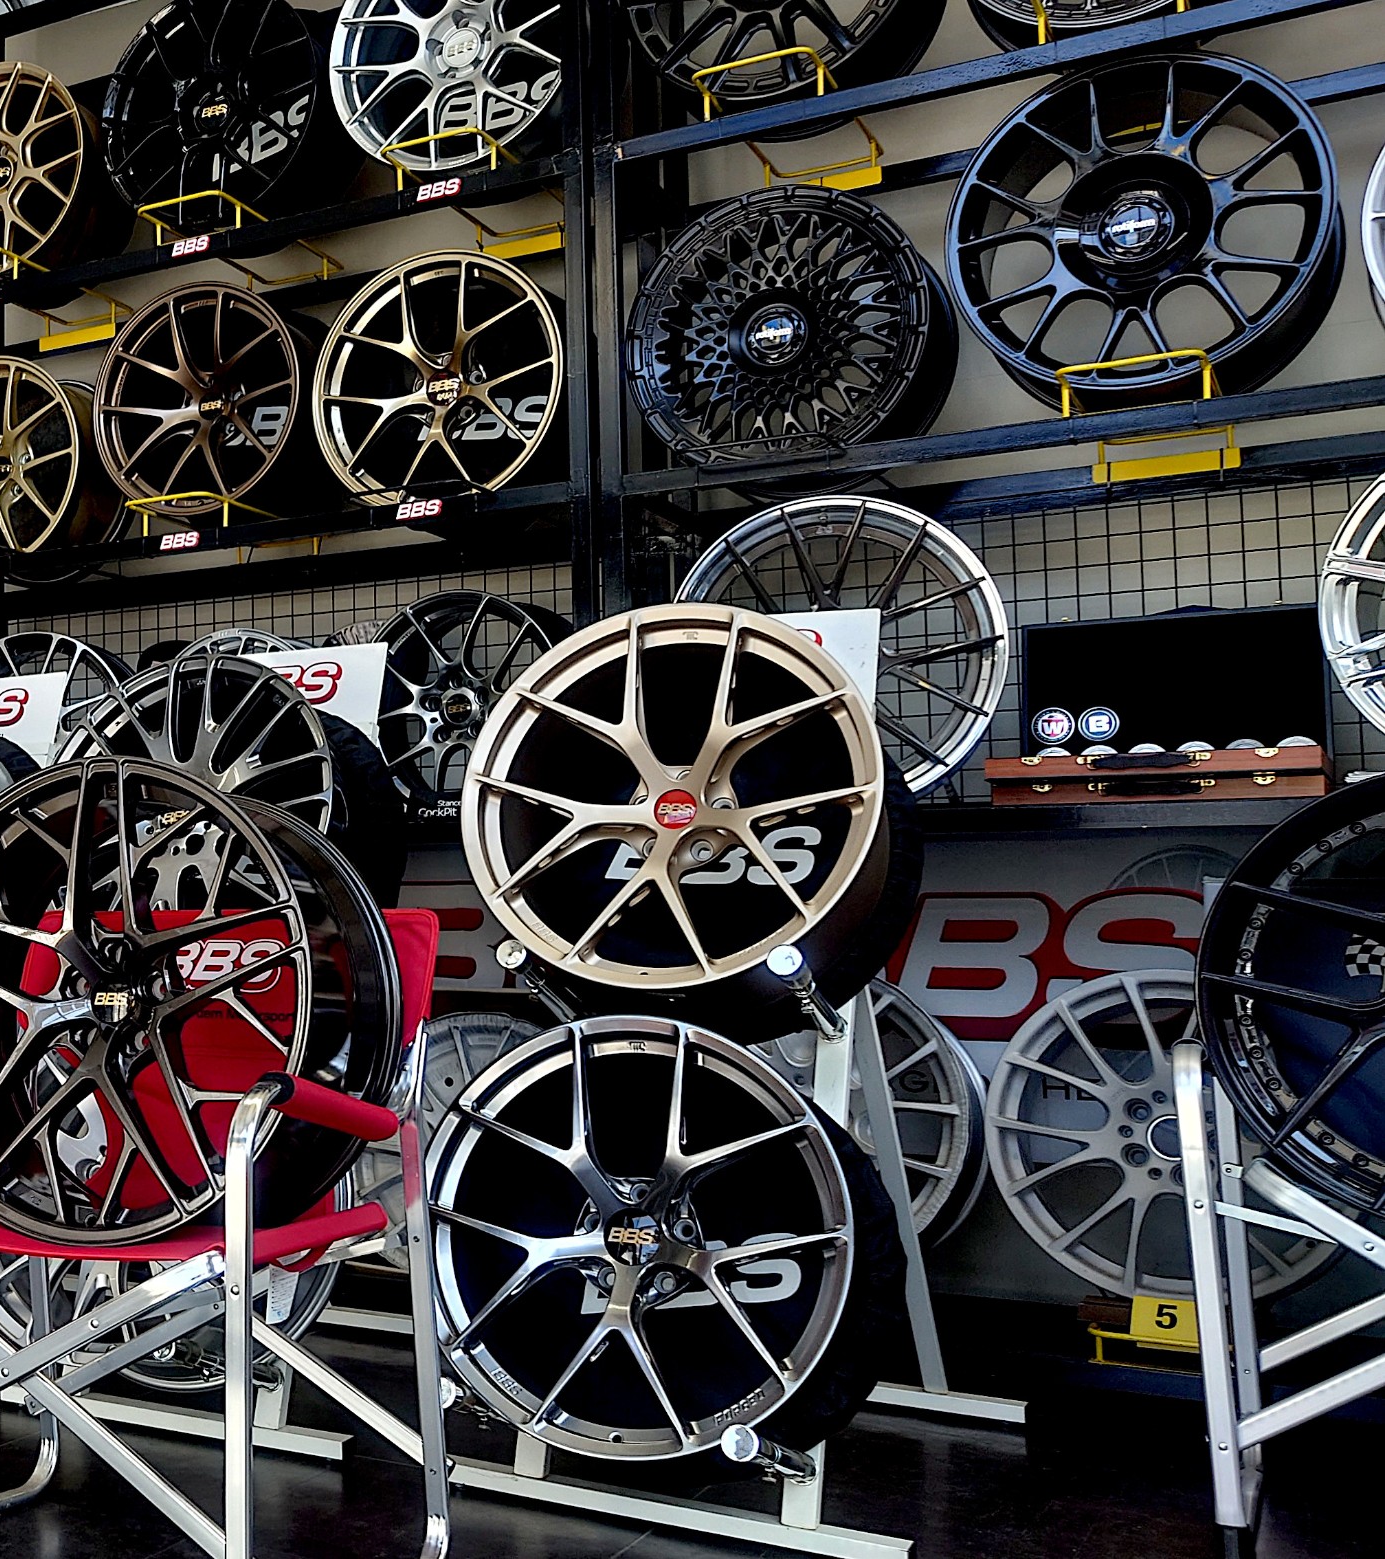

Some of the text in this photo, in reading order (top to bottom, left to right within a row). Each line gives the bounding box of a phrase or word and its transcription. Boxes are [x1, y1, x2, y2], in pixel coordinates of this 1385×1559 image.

[447, 40, 477, 58] BBS
[201, 104, 228, 118] BBS
[416, 177, 462, 202] BBS
[171, 235, 211, 258] BBS
[428, 378, 460, 393] BBS
[200, 399, 223, 412] BBS
[396, 499, 442, 521] BBS
[159, 530, 200, 551] BBS
[1088, 715, 1110, 733] B
[657, 803, 695, 816] BBS
[94, 992, 129, 1006] BBS
[607, 1226, 655, 1245] BBS
[1155, 1303, 1178, 1330] 5
